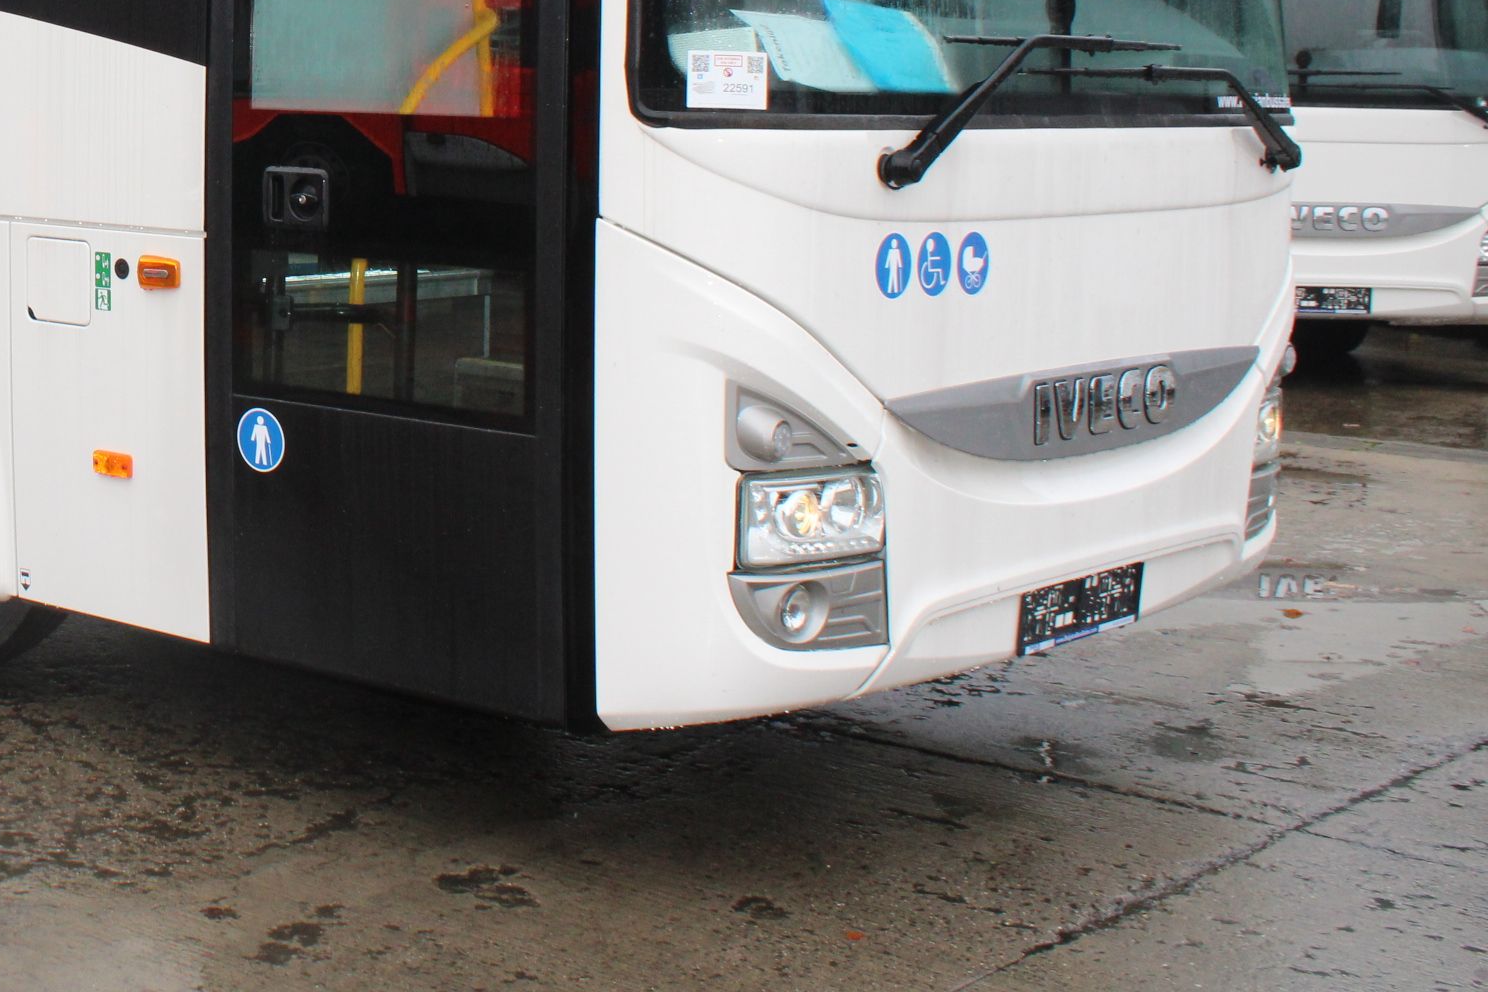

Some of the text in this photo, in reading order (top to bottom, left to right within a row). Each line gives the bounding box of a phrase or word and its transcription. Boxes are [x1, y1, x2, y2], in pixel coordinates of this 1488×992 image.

[722, 82, 755, 94] 22591
[1290, 205, 1390, 232] VECO
[1034, 364, 1177, 446] IVECO
